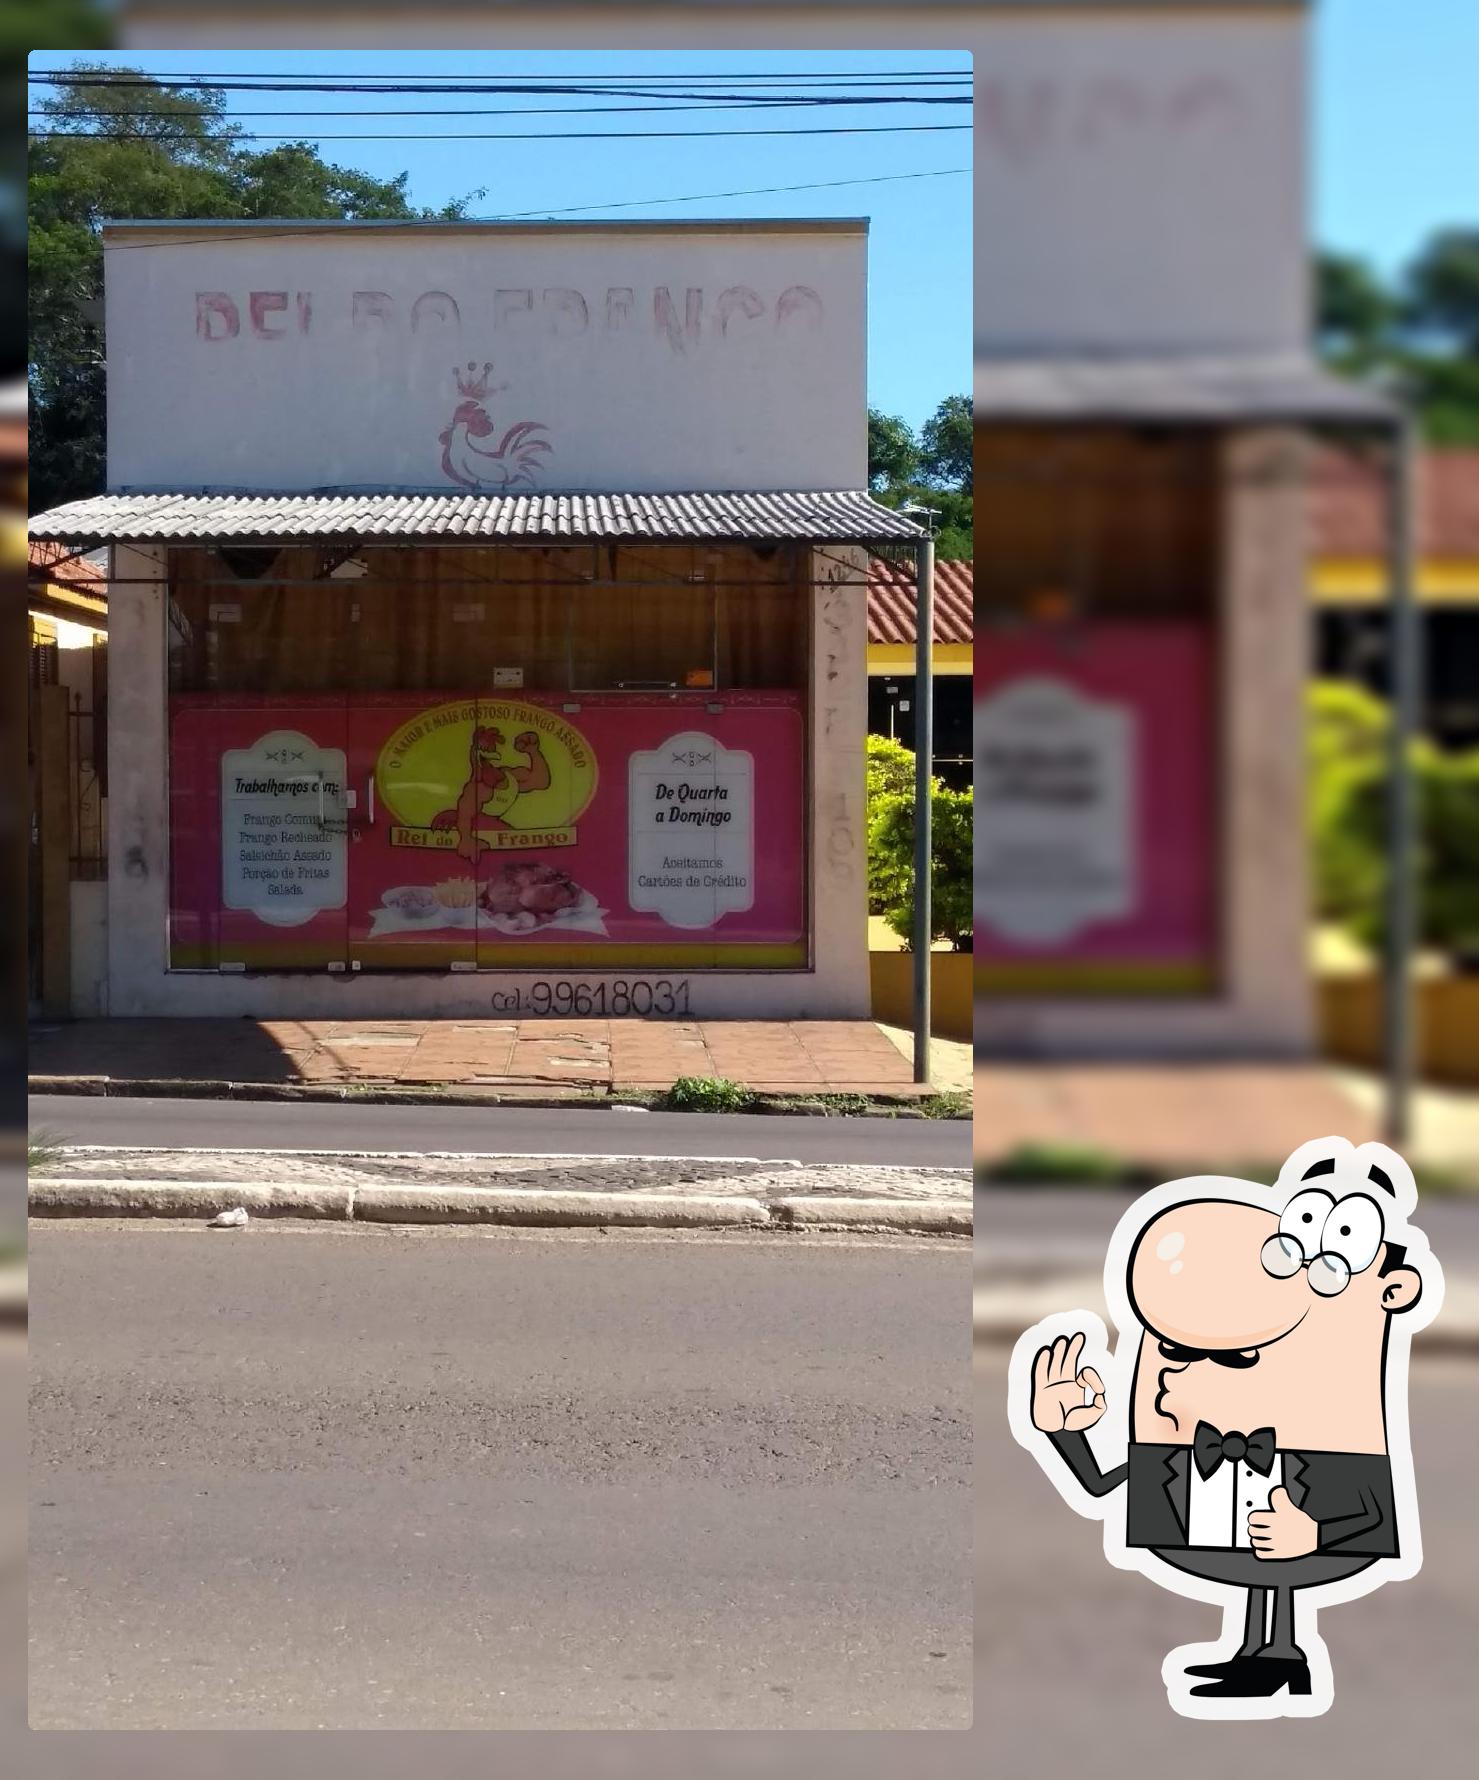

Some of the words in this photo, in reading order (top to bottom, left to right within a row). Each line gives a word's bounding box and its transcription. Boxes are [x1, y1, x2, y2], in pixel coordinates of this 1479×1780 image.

[433, 710, 460, 730] MAIS
[461, 705, 512, 723] GOSTOSO
[513, 706, 556, 732] FRANGO
[556, 726, 587, 769] ASSADO
[235, 778, 309, 797] Trabalhamos
[311, 781, 340, 796] cm:
[655, 783, 675, 800] De
[678, 783, 728, 804] Quarta
[243, 813, 282, 828] Frango
[284, 813, 322, 826] Comu
[655, 811, 665, 823] a
[668, 806, 731, 827] Domingo
[239, 831, 278, 846] Frango
[280, 830, 333, 844] Recheado
[396, 829, 427, 846] Rei
[436, 833, 453, 846] do
[497, 830, 569, 848] Frango
[293, 849, 332, 862] Assado
[662, 856, 723, 869] Aceitamos
[242, 866, 279, 882] Porção
[281, 866, 295, 879] de
[297, 866, 330, 880] Fritas
[638, 873, 683, 888] Cartões
[685, 874, 701, 888] de
[703, 872, 747, 888] Crédito
